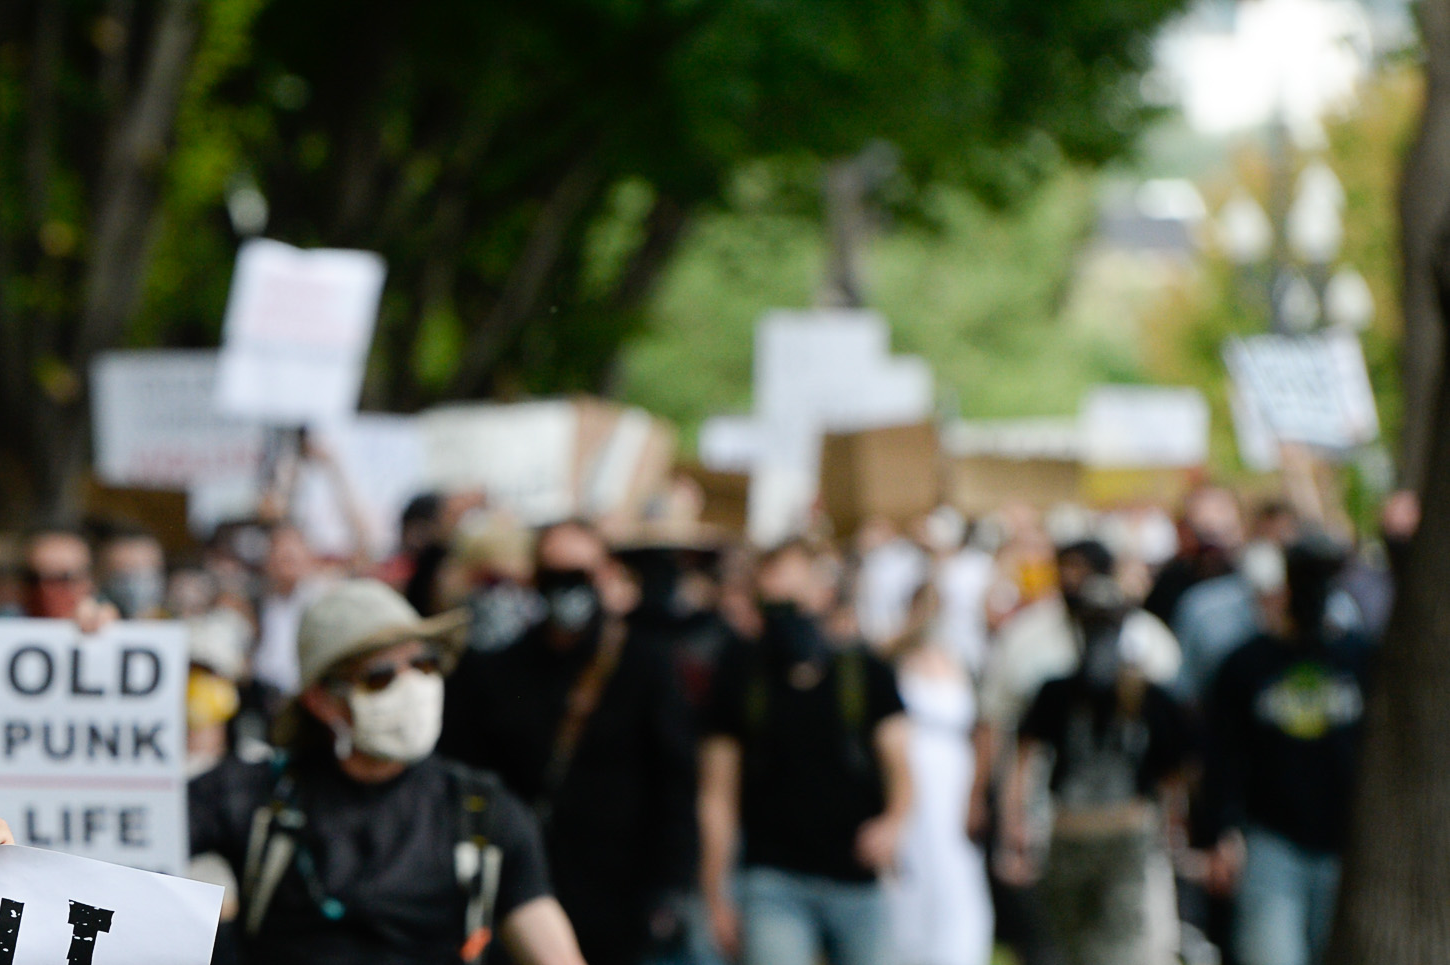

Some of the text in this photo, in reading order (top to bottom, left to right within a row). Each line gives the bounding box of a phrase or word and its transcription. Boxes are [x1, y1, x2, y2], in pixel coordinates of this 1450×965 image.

[7, 645, 163, 697] OLD
[3, 720, 167, 761] PUNK
[24, 804, 150, 846] LIFE
